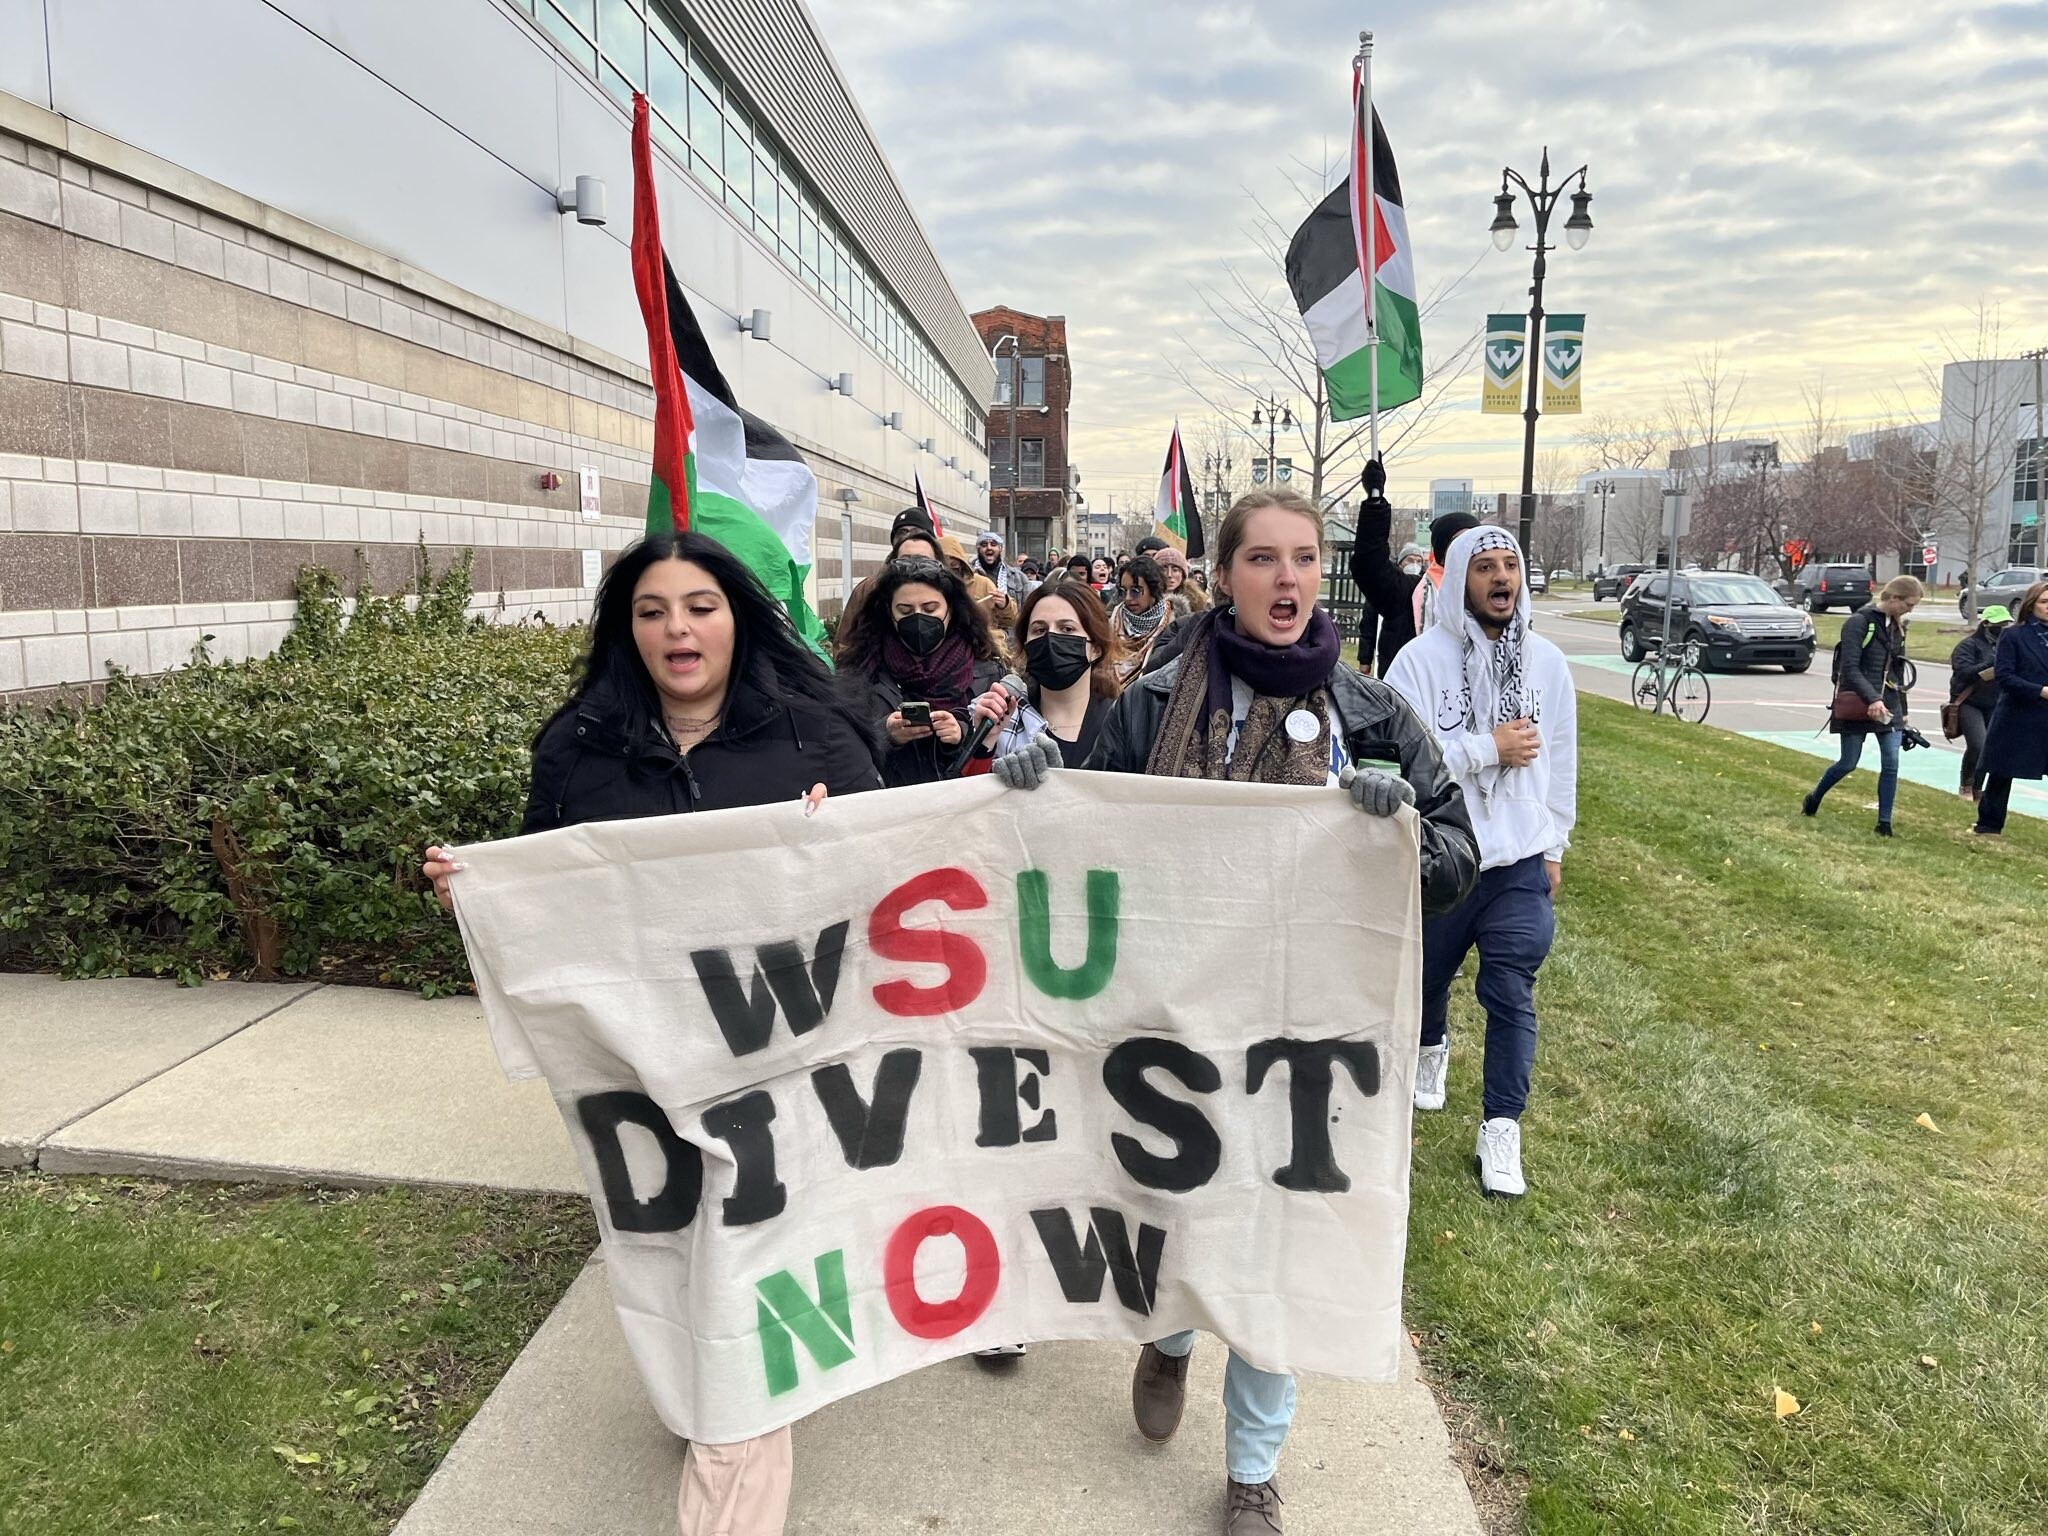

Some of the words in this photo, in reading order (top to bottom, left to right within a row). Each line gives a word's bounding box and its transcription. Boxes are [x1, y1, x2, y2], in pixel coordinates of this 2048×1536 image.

[690, 868, 1119, 1056] WSU
[577, 1037, 1381, 1233] DIVEST
[755, 1205, 1166, 1397] NOW
